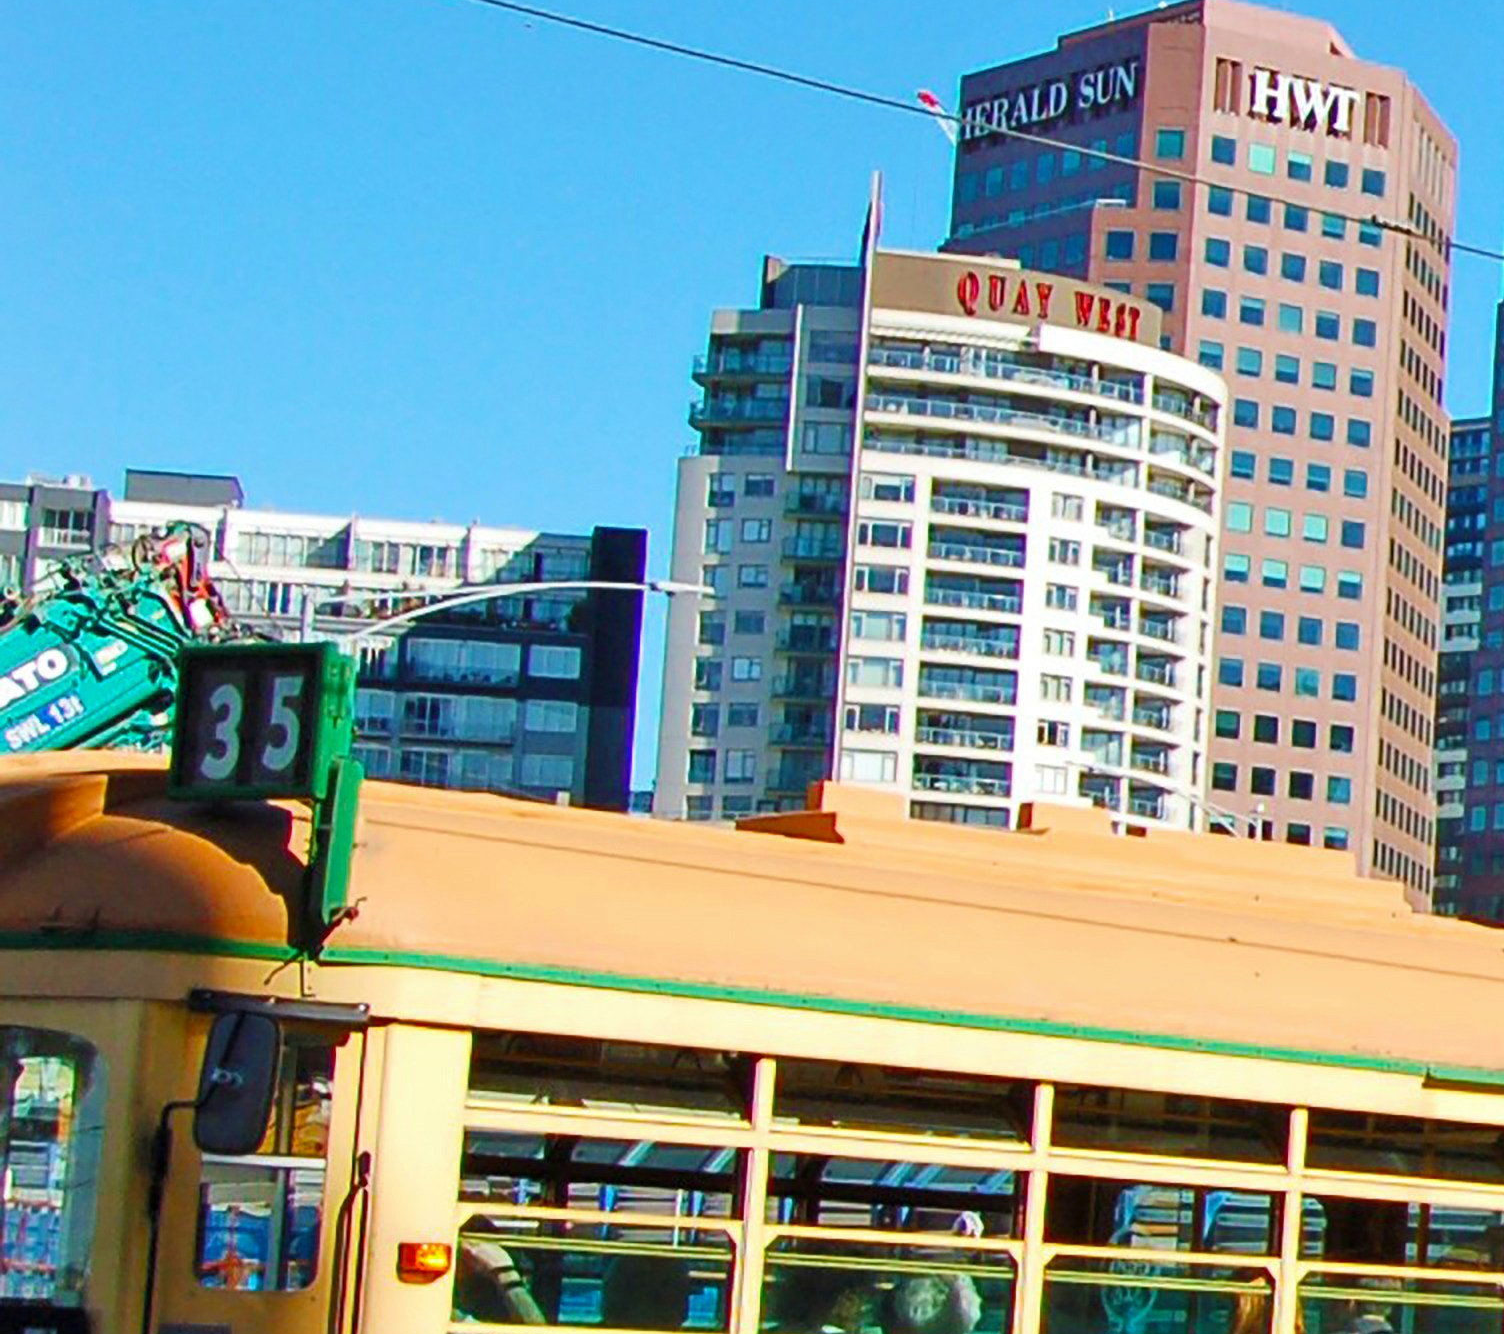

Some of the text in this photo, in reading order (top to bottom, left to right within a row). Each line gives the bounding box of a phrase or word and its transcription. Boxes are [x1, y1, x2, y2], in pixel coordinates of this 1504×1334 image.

[1079, 62, 1138, 108] SUN
[1252, 69, 1361, 132] HWT
[957, 271, 1141, 342] QUAY WEST
[4, 714, 51, 750] SWL
[200, 675, 304, 779] 35
